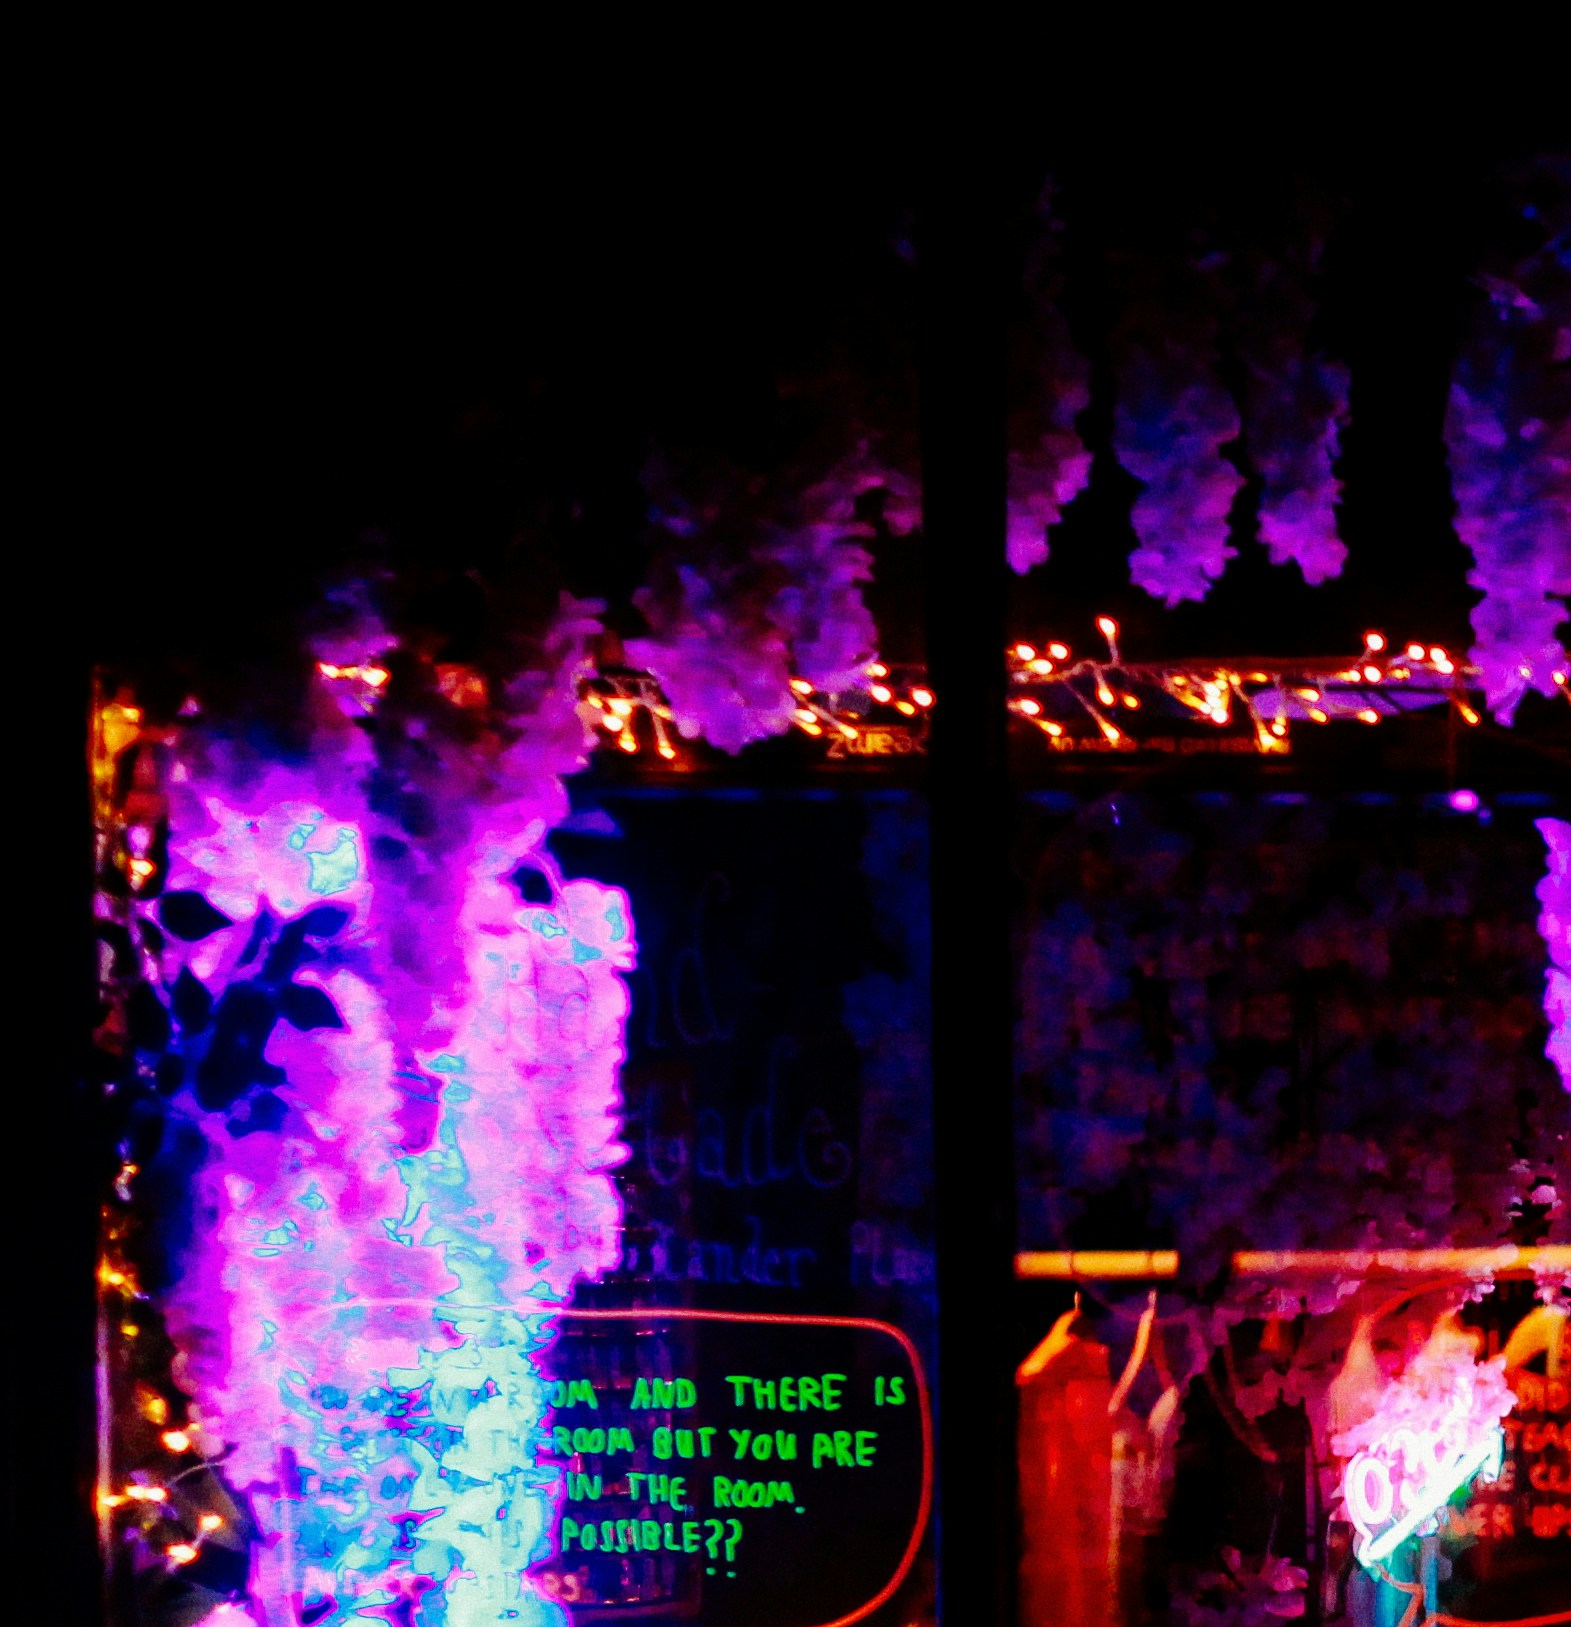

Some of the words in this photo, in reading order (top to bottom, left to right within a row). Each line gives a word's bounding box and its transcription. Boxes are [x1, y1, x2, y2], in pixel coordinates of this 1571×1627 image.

[630, 1376, 697, 1410] AND
[725, 1373, 847, 1412] THERE
[874, 1375, 907, 1407] IS
[551, 1426, 635, 1457] ROOM
[652, 1426, 717, 1461] BUT
[728, 1427, 798, 1461] YOU
[812, 1429, 880, 1469] ARE
[565, 1470, 601, 1501] IN
[625, 1470, 688, 1511] THE
[561, 1516, 744, 1578] POSSIBLE??
